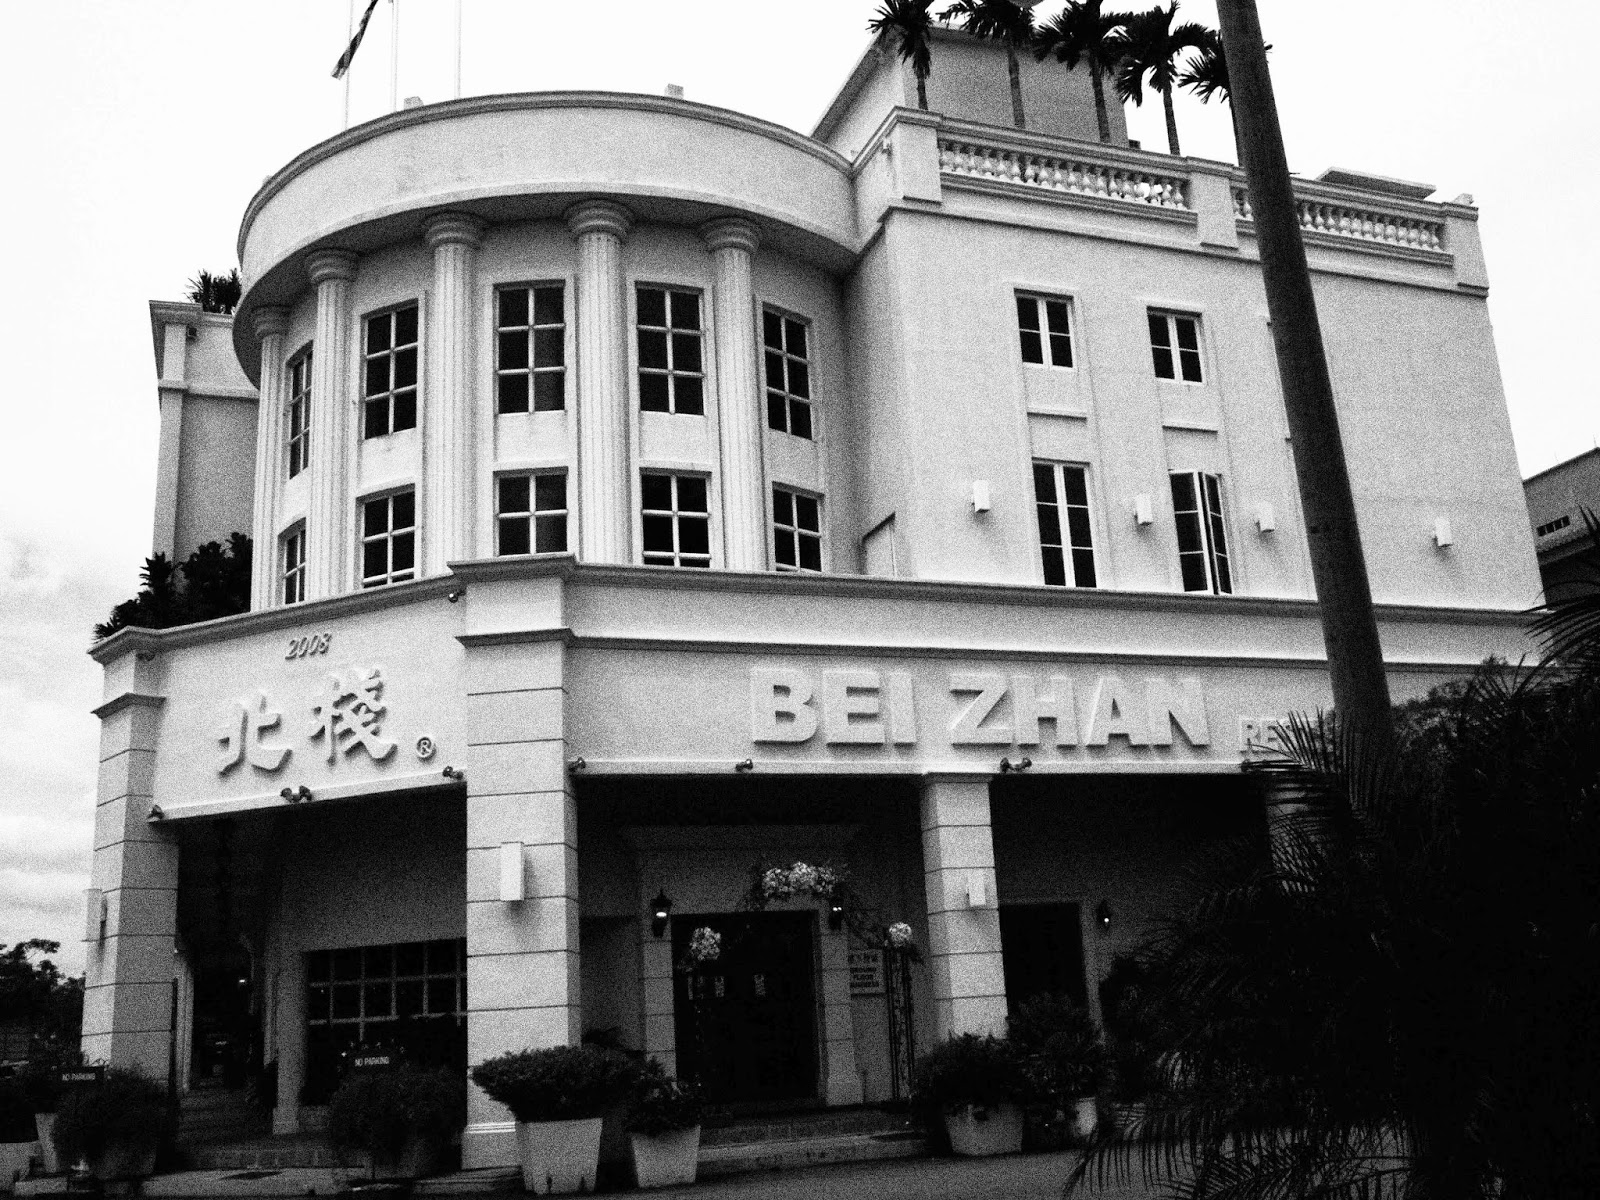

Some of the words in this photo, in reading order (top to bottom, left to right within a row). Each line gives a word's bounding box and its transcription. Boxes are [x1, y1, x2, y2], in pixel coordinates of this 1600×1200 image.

[285, 633, 332, 660] 2008
[750, 667, 918, 752] BEI
[947, 673, 1212, 752] ZHAN
[354, 1058, 363, 1067] NO
[364, 1056, 390, 1066] PARKING
[71, 1072, 96, 1081] PARKING
